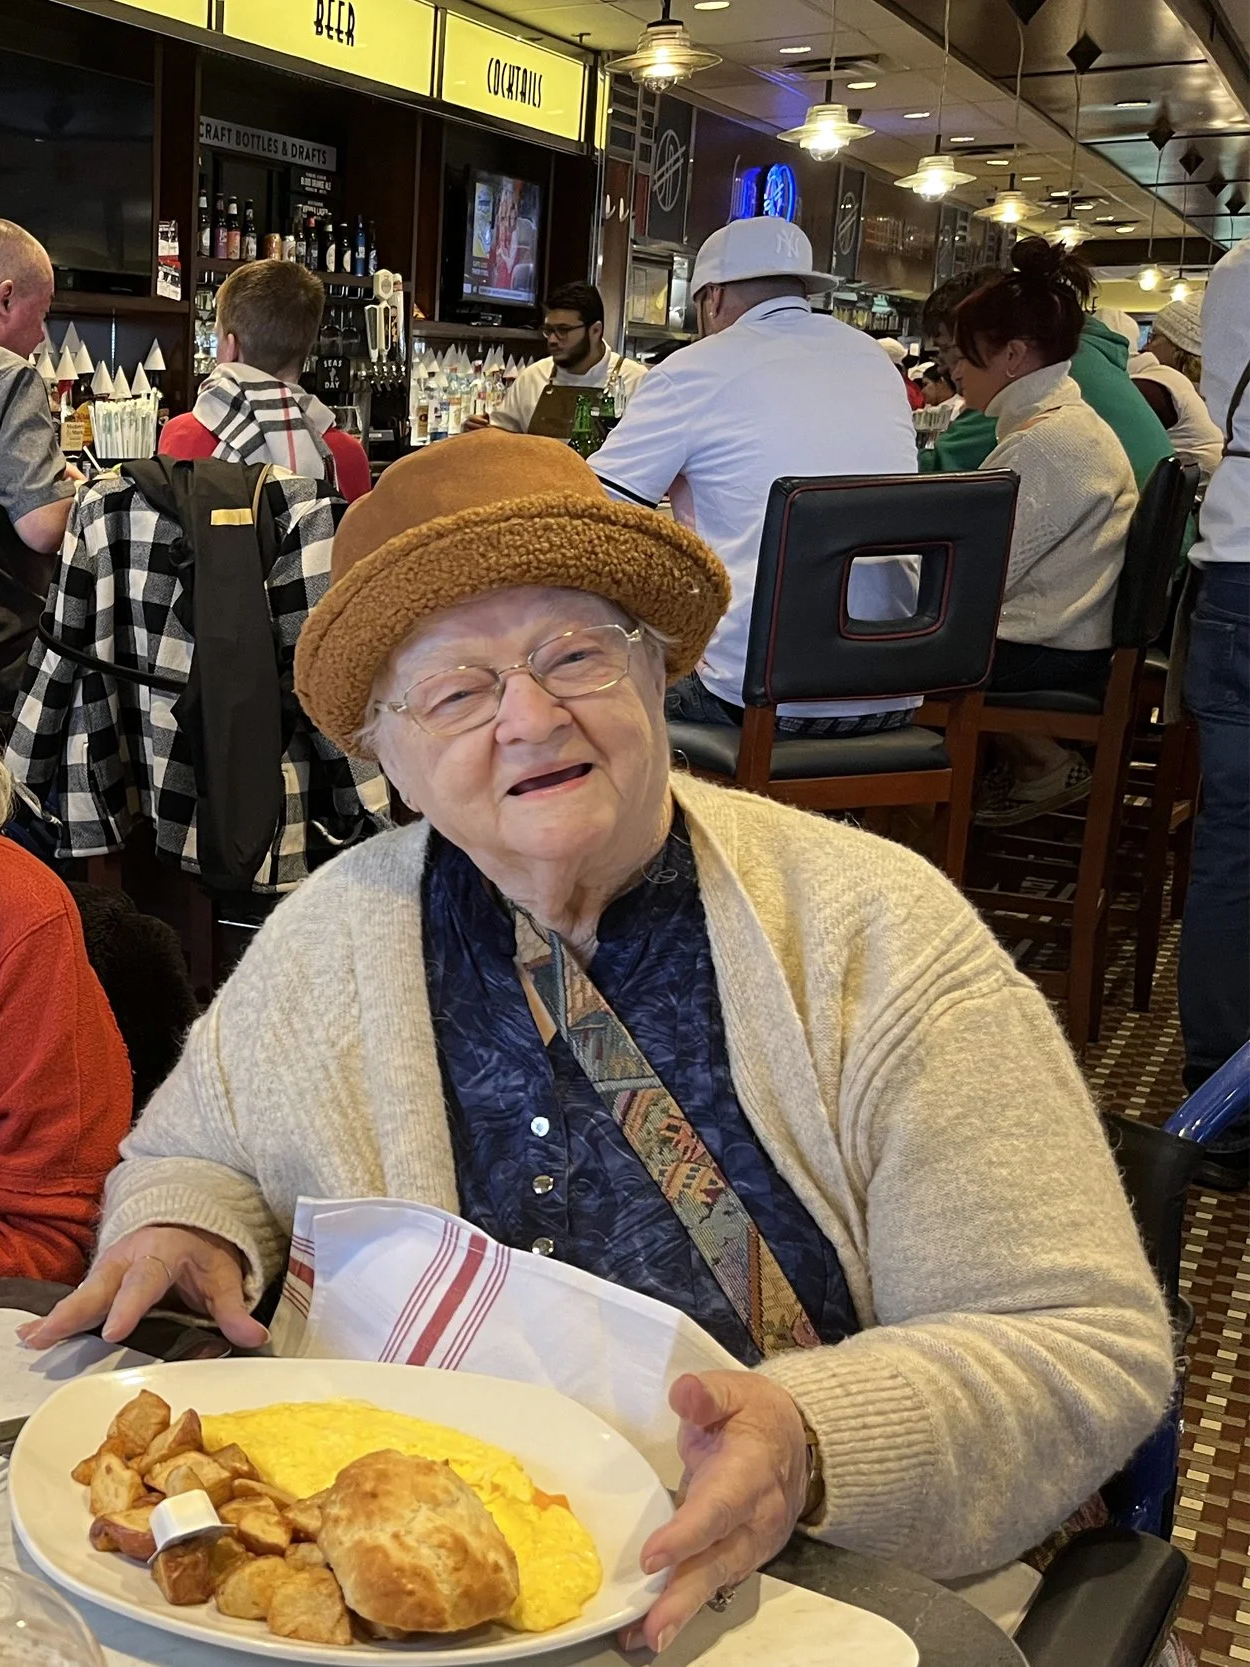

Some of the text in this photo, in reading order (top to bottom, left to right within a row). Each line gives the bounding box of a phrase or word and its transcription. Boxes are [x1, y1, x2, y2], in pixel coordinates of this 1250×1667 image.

[313, 0, 356, 47] BEER
[487, 57, 543, 109] COCKTAILS
[235, 129, 279, 154] BOTTLES
[281, 141, 288, 156] &
[291, 143, 327, 165] DRAFTS
